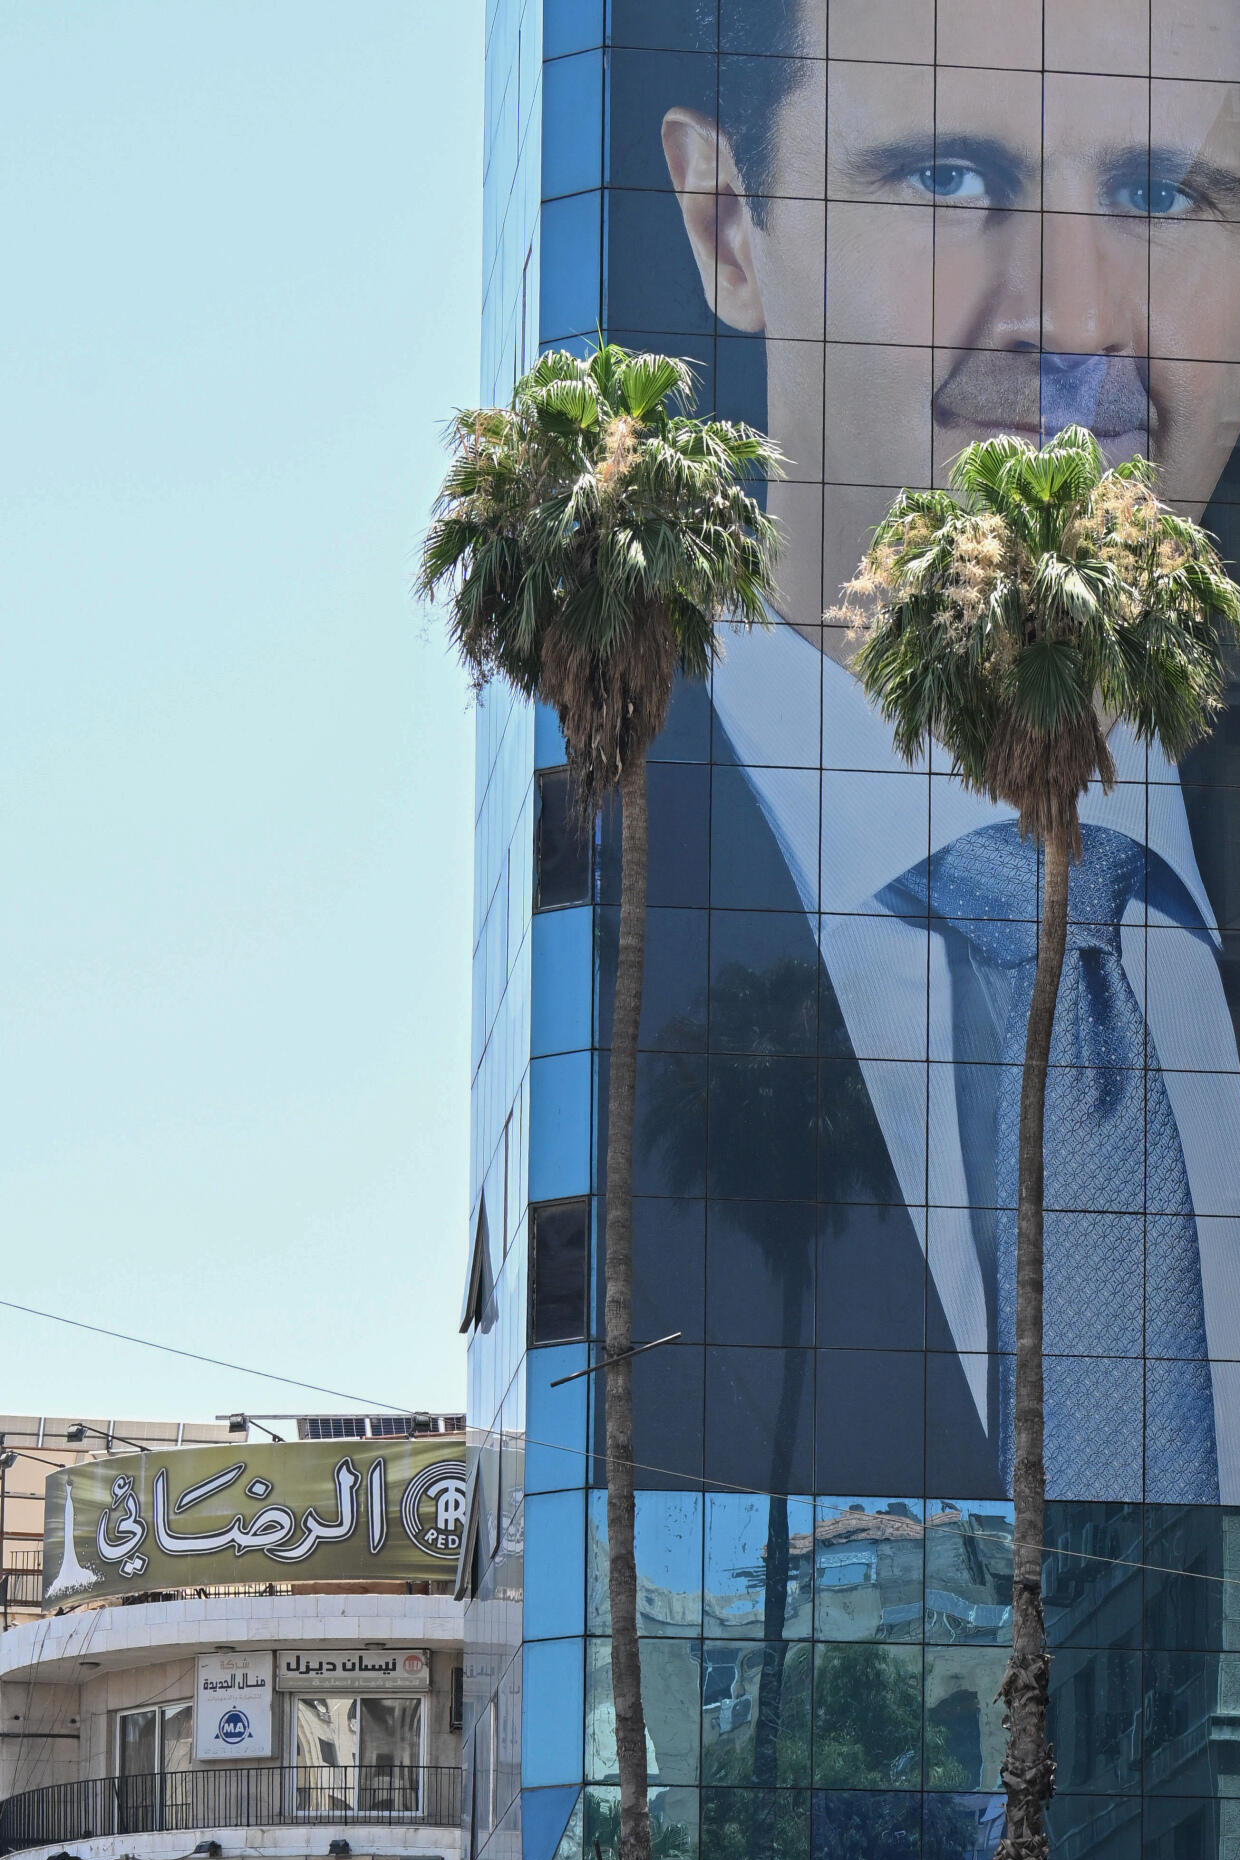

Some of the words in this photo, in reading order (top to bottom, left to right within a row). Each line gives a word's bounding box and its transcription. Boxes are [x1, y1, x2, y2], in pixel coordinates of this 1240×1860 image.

[424, 1528, 460, 1549] RED
[219, 1657, 250, 1669] شركة
[286, 1655, 337, 1674] ديزل
[342, 1656, 397, 1673] نيسان
[203, 1673, 236, 1691] الجديدة
[238, 1673, 266, 1690] منال
[223, 1722, 244, 1733] MA
